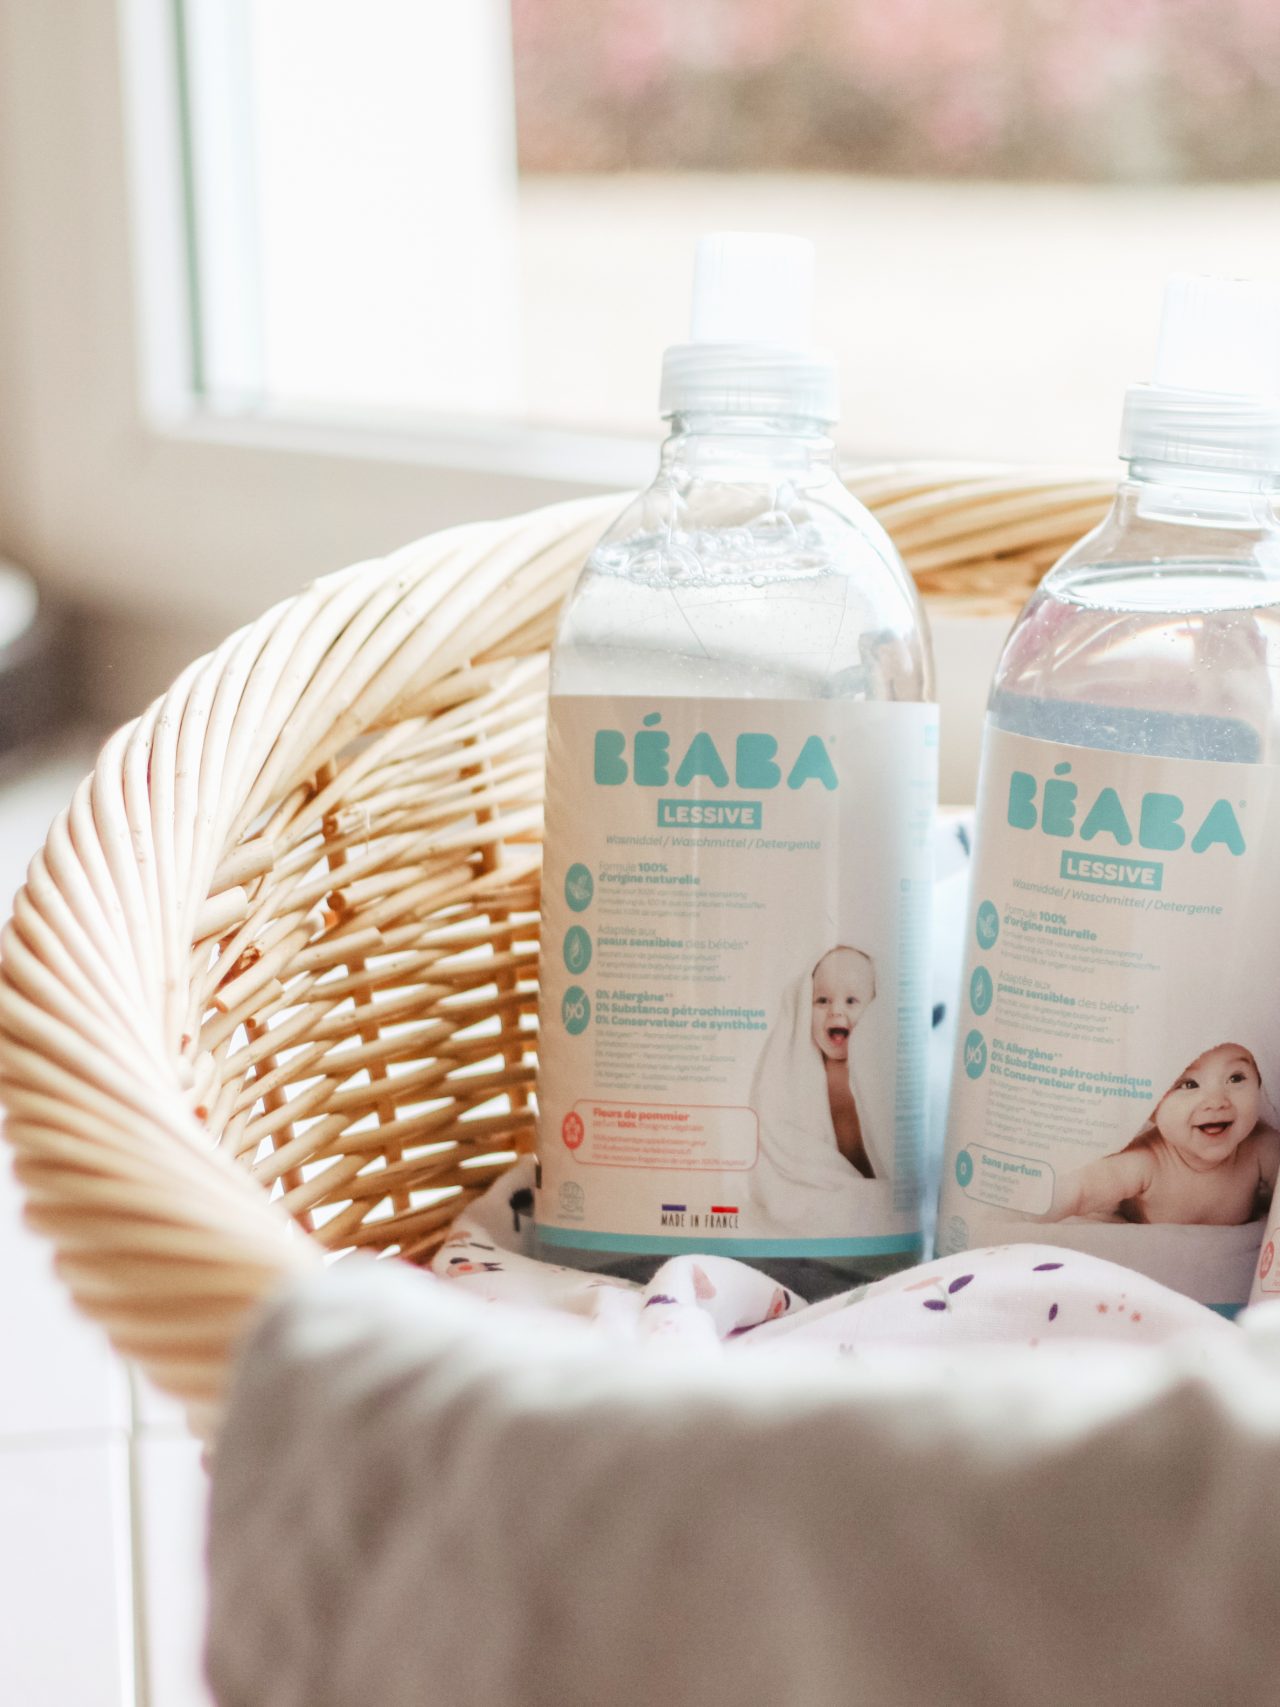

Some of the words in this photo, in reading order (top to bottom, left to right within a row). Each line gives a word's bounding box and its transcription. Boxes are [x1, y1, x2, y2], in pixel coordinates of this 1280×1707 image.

[594, 711, 839, 791] BÉABA
[664, 806, 754, 825] LESSIVE
[1007, 761, 1246, 857] BÉABA
[606, 834, 661, 847] Wasmiddel
[671, 834, 746, 848] Waschmittel
[755, 837, 821, 852] Detergente
[599, 862, 636, 871] Formule
[638, 862, 668, 873] 100%
[1067, 857, 1155, 886] LESSIVE
[599, 873, 644, 885] d'origine
[645, 875, 700, 885] naturelle
[1012, 877, 1064, 898] Wasmiddel
[1072, 889, 1145, 908] Waschmittel
[1154, 900, 1223, 917] Detergente
[1005, 903, 1039, 918] Formule
[1039, 911, 1067, 925] 100%
[639, 927, 656, 936] aux
[1004, 915, 1043, 933] d'origine
[1045, 923, 1097, 941] naturelle
[597, 938, 628, 948] peaux
[629, 937, 684, 948] sensibles
[685, 938, 706, 949] des
[596, 990, 610, 999] 0%
[997, 984, 1024, 997] peaux
[1026, 988, 1076, 1006] sensibles
[1078, 995, 1097, 1008] des
[596, 1003, 610, 1012] 0%
[611, 1003, 669, 1014] Substance
[672, 1005, 766, 1020] pétrochimique
[595, 1016, 610, 1025] 0%
[611, 1016, 688, 1028] Conservateur
[692, 1019, 707, 1029] de
[709, 1019, 768, 1032] synthèse
[992, 1039, 1004, 1050] 0%
[991, 1052, 1003, 1062] 0%
[1005, 1054, 1057, 1075] Substance
[1059, 1067, 1152, 1091] pétrochimique
[990, 1064, 1002, 1075] 0%
[1003, 1067, 1074, 1090] Conservateur
[1078, 1081, 1092, 1093] de
[1095, 1083, 1153, 1100] synthèse
[593, 1107, 622, 1118] Fleurs
[624, 1109, 637, 1119] de
[639, 1111, 690, 1123] pommier
[618, 1120, 637, 1128] 100%
[982, 1154, 1002, 1168] Sans
[1003, 1161, 1042, 1178] parfum
[661, 1213, 685, 1228] MADE
[691, 1214, 699, 1228] IN
[705, 1214, 739, 1229] FRANCE
